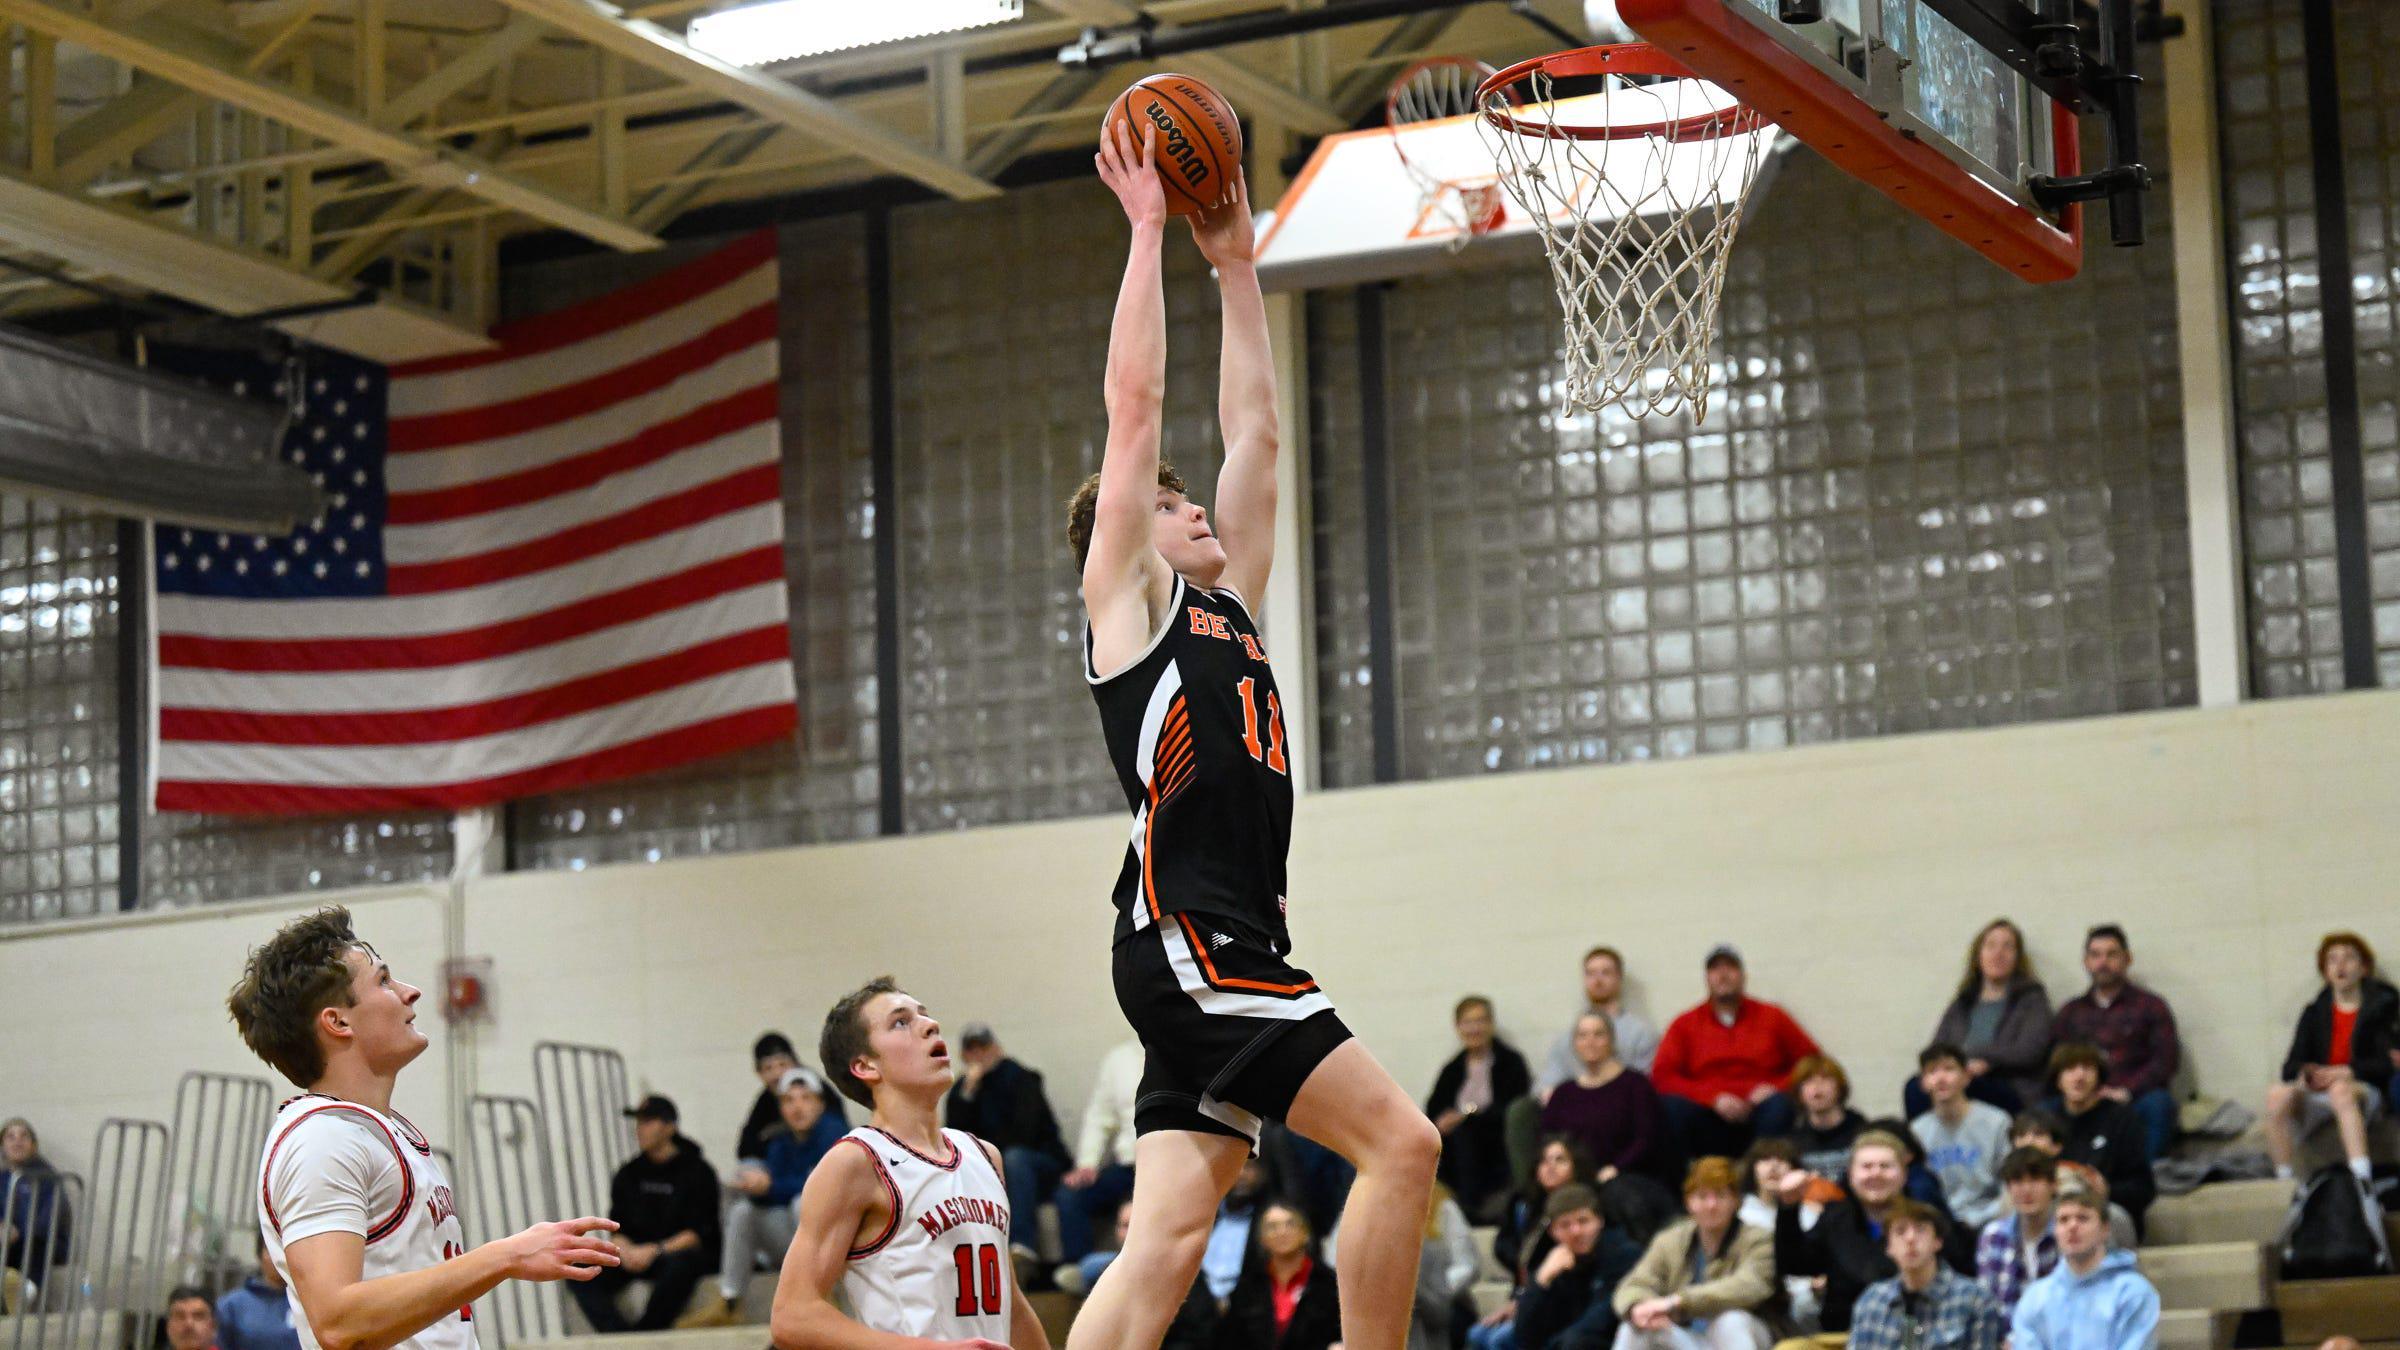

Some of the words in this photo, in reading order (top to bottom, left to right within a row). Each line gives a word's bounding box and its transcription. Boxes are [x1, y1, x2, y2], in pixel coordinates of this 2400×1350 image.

[1145, 99, 1209, 189] Wilson
[1237, 675, 1286, 776] 11
[953, 1243, 1001, 1317] 10
